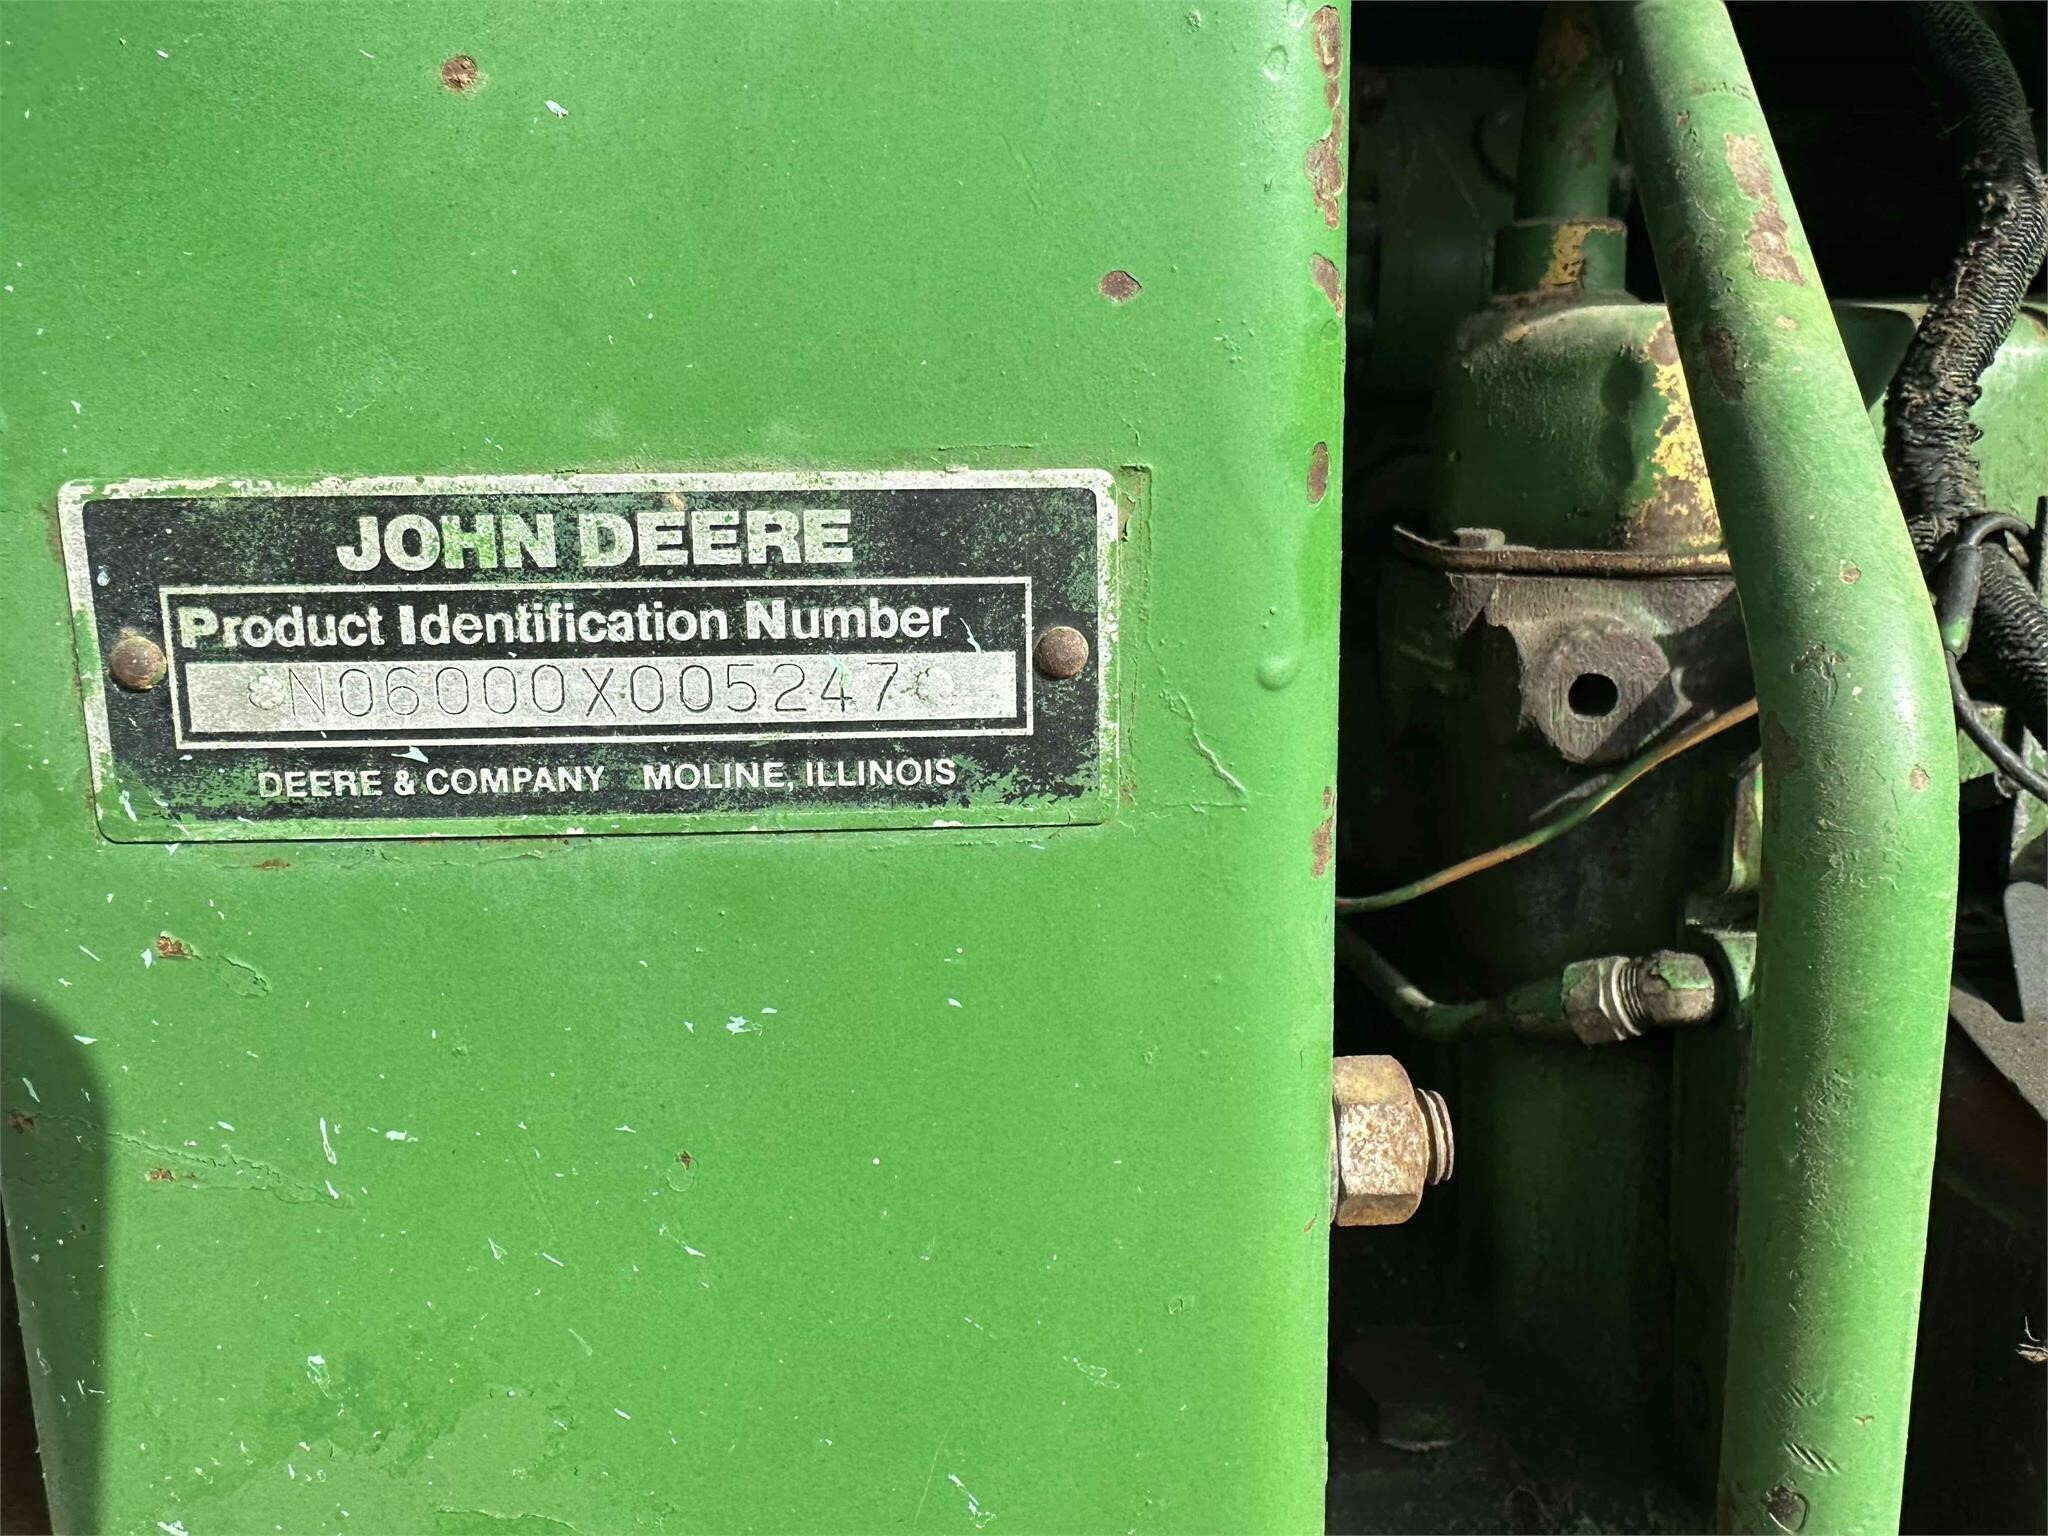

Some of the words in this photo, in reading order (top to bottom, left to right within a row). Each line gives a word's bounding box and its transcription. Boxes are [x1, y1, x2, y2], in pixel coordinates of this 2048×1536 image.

[336, 512, 557, 571] JOHN
[580, 509, 854, 567] DEERE
[177, 605, 385, 648] Product
[399, 601, 727, 646] Identification
[746, 598, 950, 640] Number
[289, 662, 899, 717] N06000X005247
[258, 769, 383, 799] DEERE
[393, 769, 416, 796] &
[426, 766, 605, 795] COMPANY
[643, 762, 794, 791] MOLINE,
[806, 759, 957, 787] ILLINOIS
